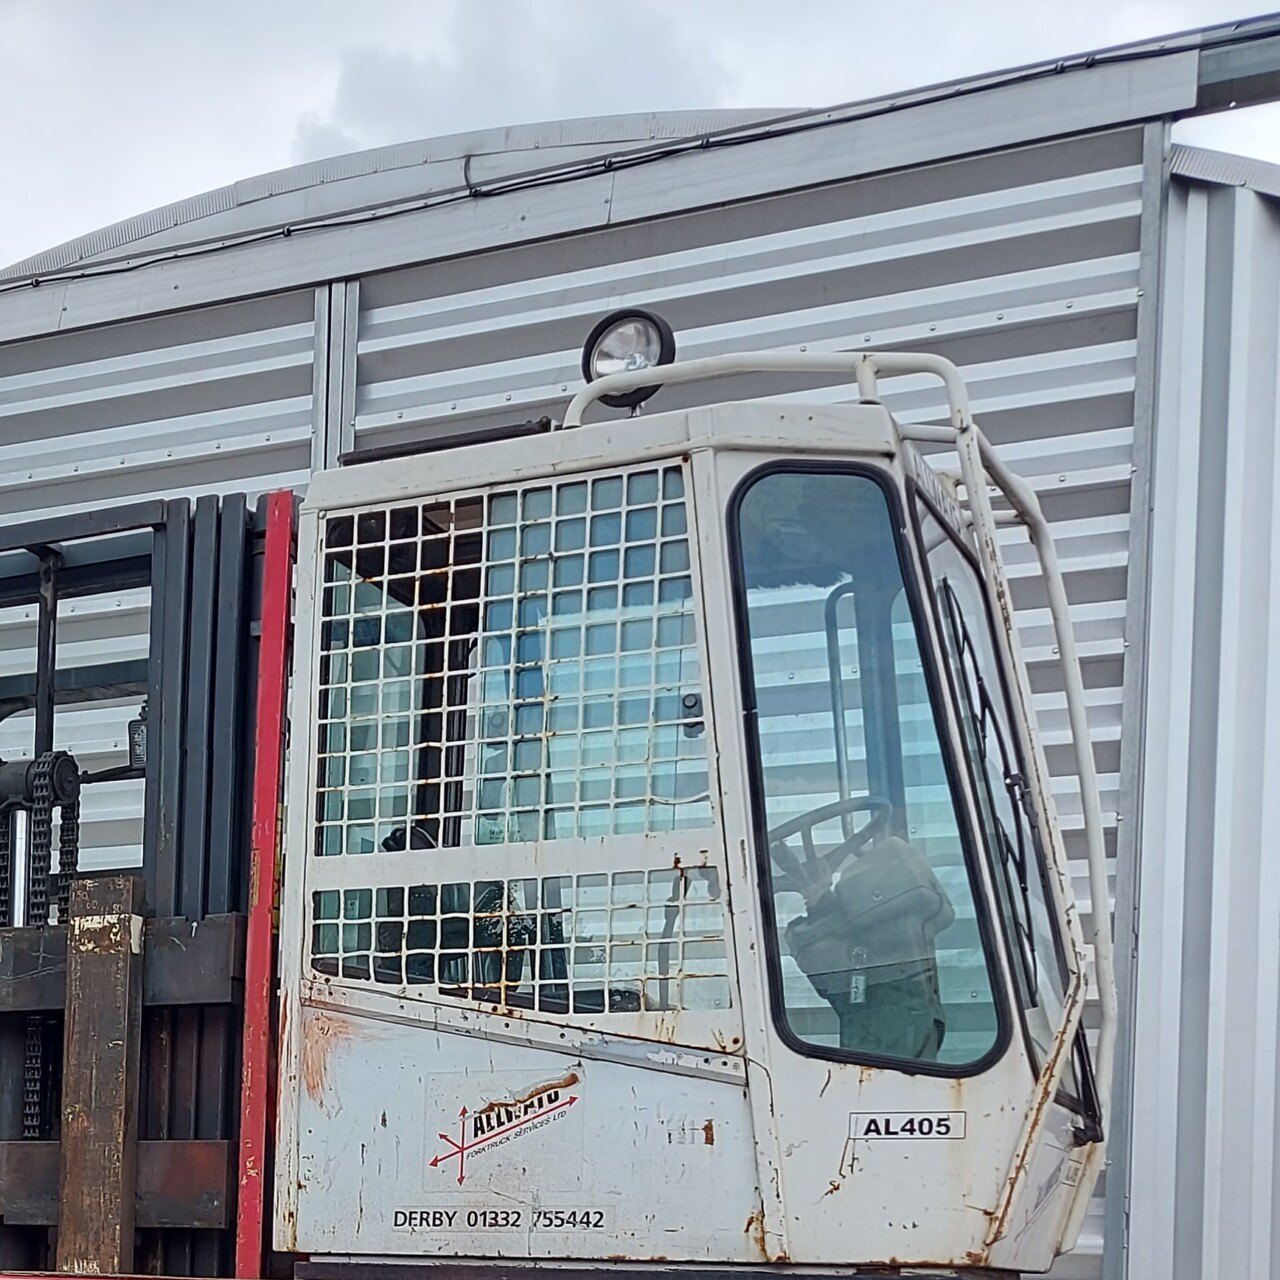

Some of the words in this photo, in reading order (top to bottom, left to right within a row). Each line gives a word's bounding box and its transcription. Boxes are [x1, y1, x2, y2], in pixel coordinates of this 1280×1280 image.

[513, 1115, 551, 1140] SERVICES
[552, 1109, 567, 1122] LTD
[863, 1117, 951, 1136] AL405
[393, 1210, 458, 1228] DERBY
[466, 1210, 521, 1228] 01332
[532, 1210, 605, 1228] 755442
